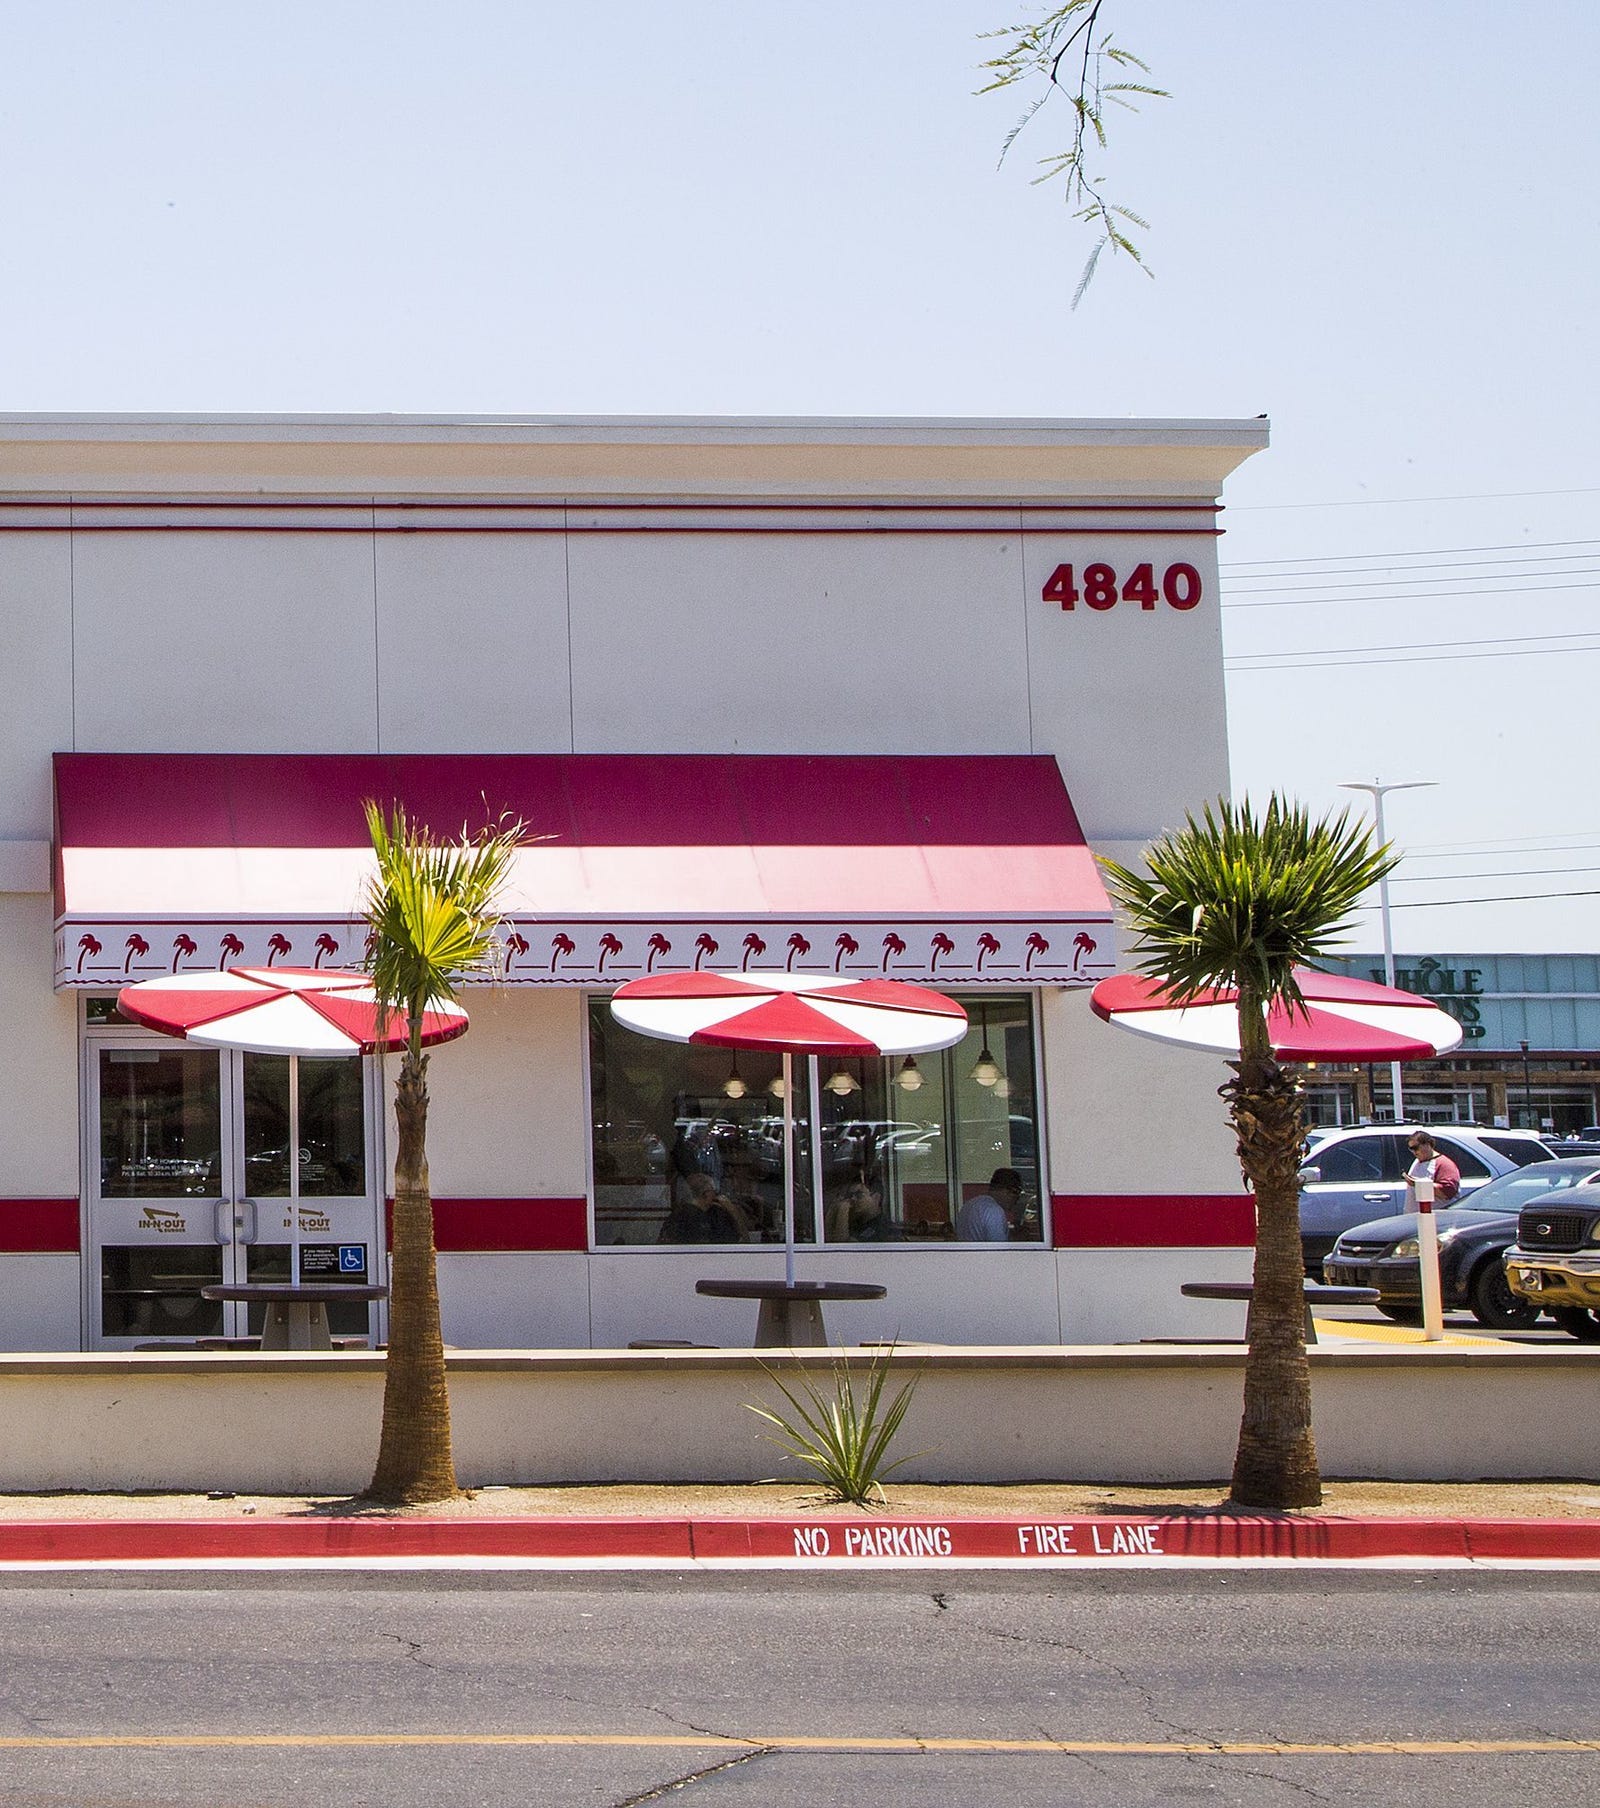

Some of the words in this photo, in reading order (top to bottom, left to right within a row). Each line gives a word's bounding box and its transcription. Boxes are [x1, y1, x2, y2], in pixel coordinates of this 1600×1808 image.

[1041, 562, 1202, 611] 4840
[138, 1219, 186, 1229] IN-N-OUT
[793, 1527, 830, 1557] NO
[844, 1527, 952, 1556] PARKING
[1017, 1525, 1078, 1554] FIRE
[1092, 1525, 1164, 1554] LANE
